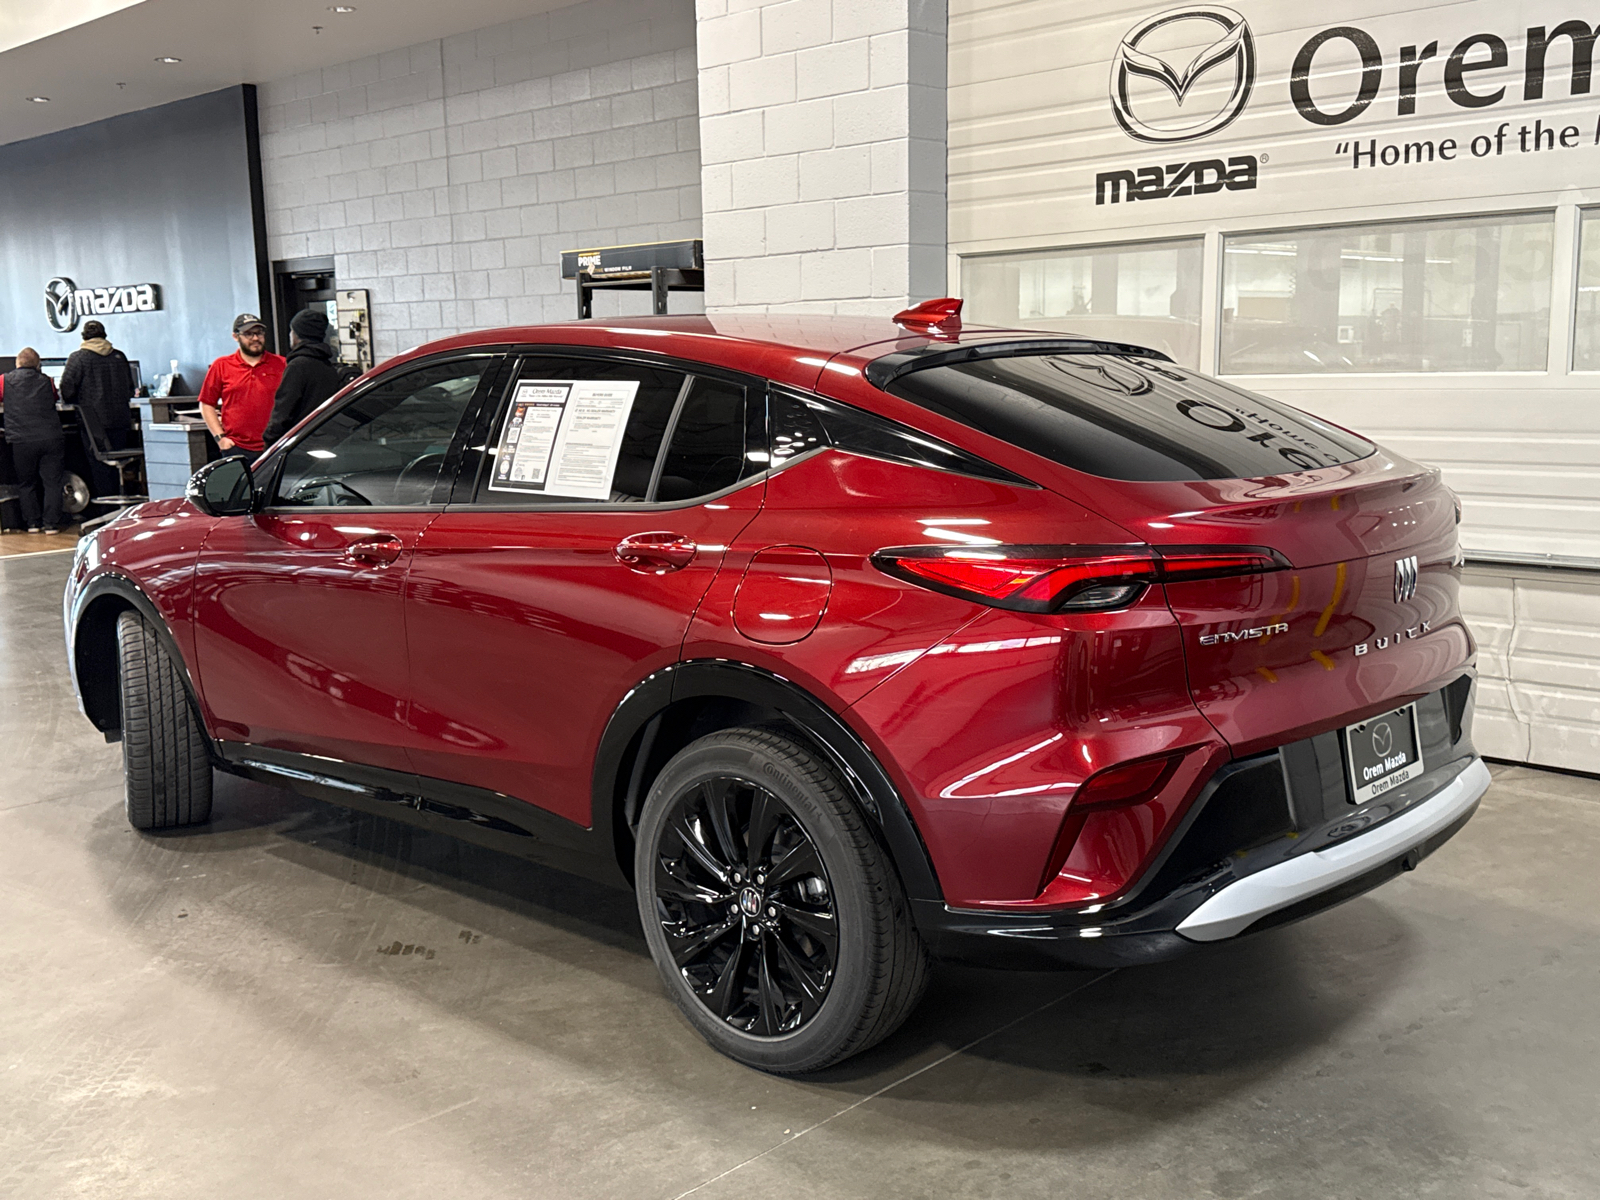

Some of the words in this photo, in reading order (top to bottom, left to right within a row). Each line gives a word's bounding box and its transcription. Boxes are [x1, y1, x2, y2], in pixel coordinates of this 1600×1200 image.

[1290, 20, 1600, 125] Orem
[1470, 122, 1510, 158] of
[1517, 119, 1580, 153] the
[1199, 622, 1289, 646] ENVISTA
[1354, 620, 1431, 657] BUICK
[1363, 765, 1384, 781] Orem
[1384, 751, 1407, 771] Mazda
[1371, 780, 1389, 795] Orem
[1389, 770, 1410, 786] Mazda
[763, 761, 818, 813] Continental
